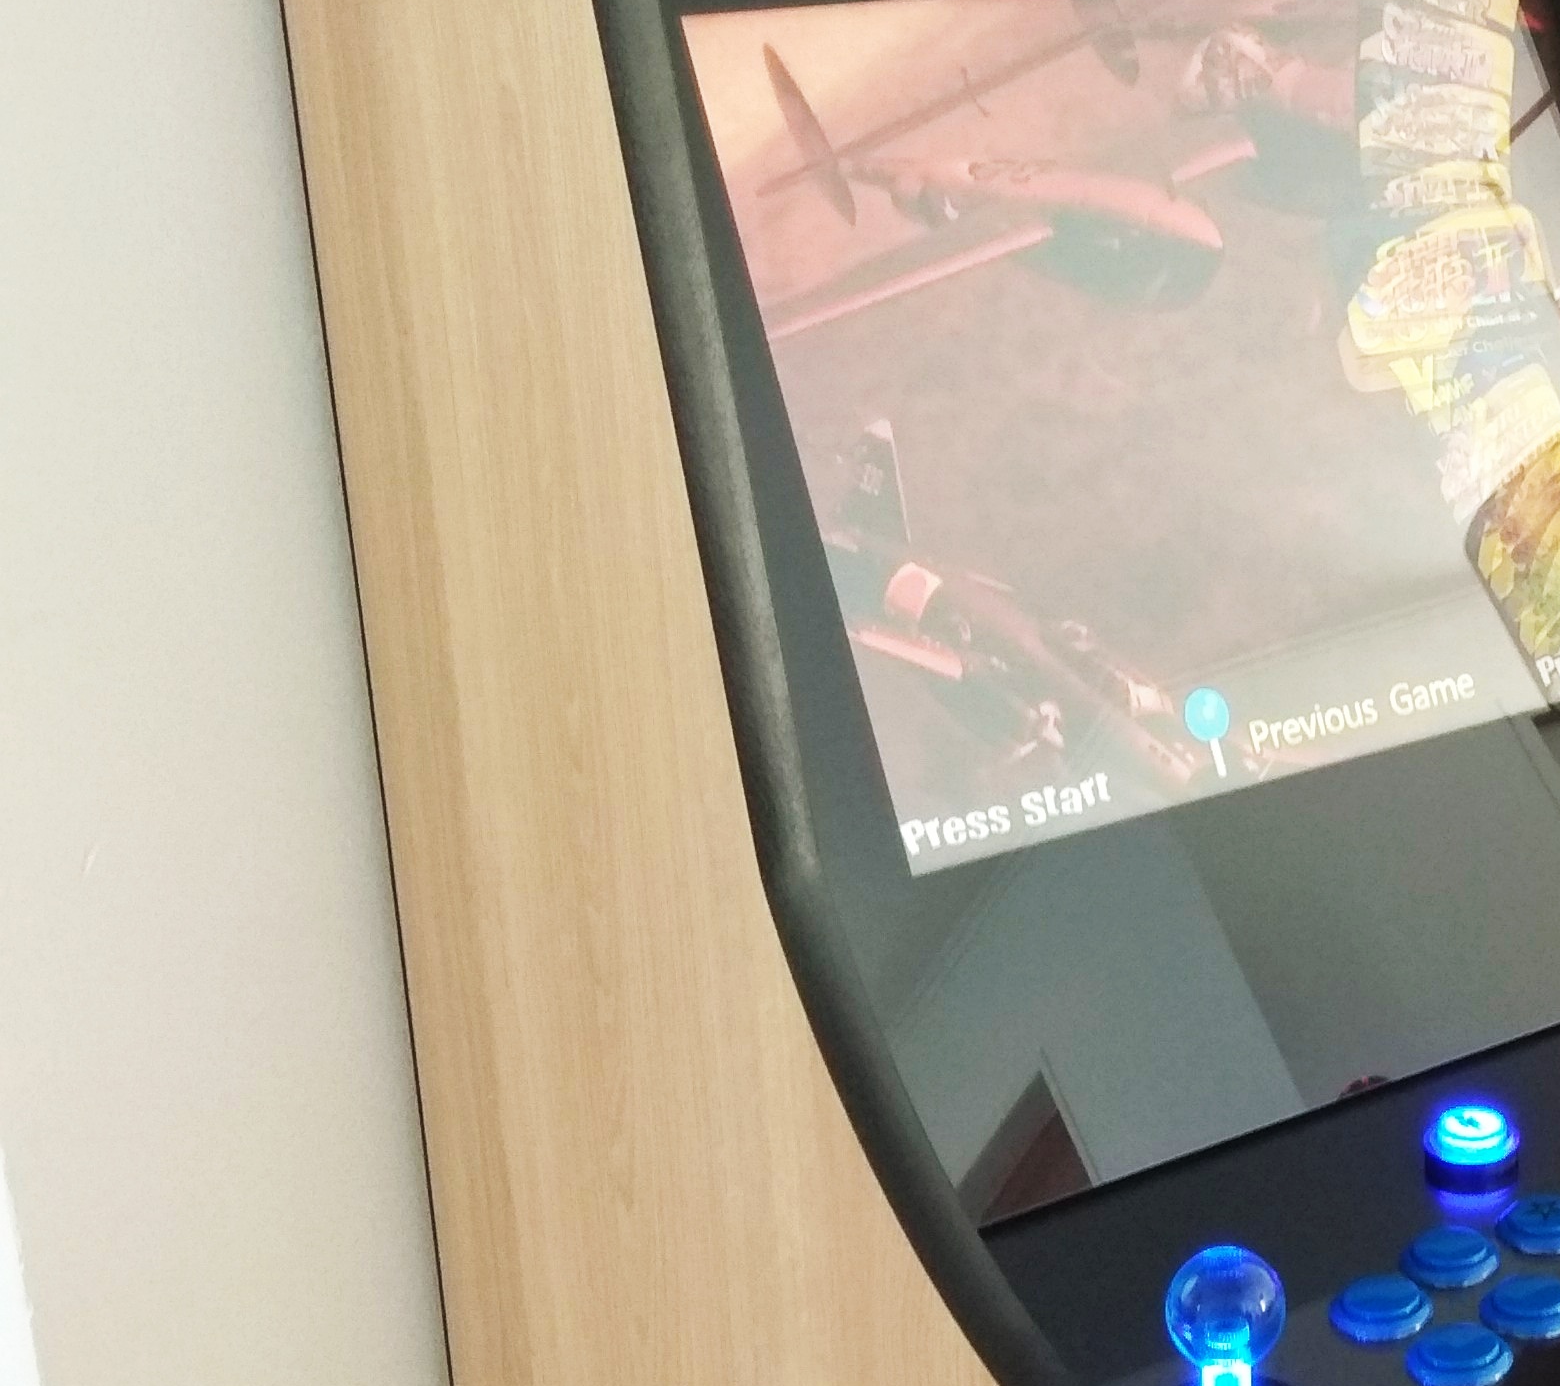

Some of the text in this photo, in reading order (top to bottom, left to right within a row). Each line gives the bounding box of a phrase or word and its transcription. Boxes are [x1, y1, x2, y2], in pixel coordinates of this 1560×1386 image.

[1248, 670, 1477, 756] Previous Game
[900, 770, 1114, 856] Press Start
